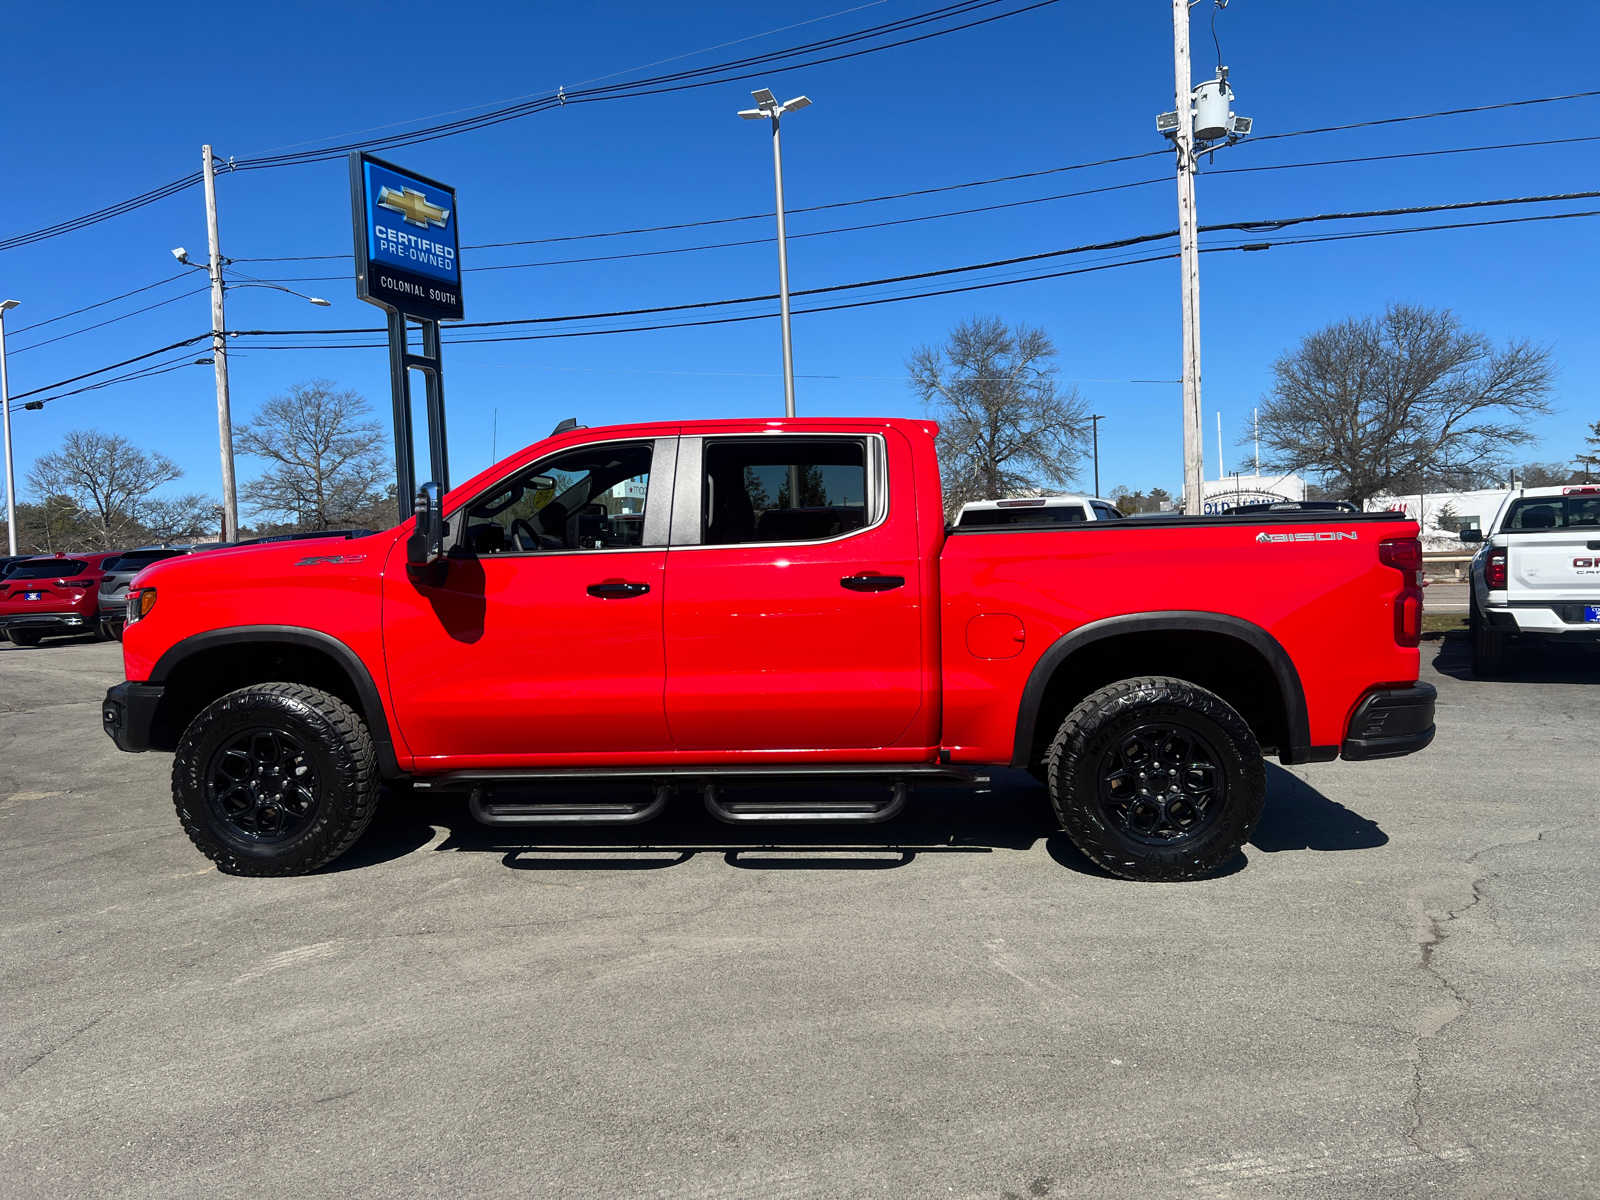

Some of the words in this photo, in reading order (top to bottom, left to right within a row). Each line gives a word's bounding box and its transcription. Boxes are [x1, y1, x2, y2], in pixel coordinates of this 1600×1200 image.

[375, 225, 455, 259] CERTIFIED
[380, 239, 452, 270] PRE-OWNED
[380, 276, 425, 297] COLONIAL
[429, 288, 456, 305] SOUTH
[1270, 531, 1358, 542] BISON
[1573, 557, 1600, 568] G
